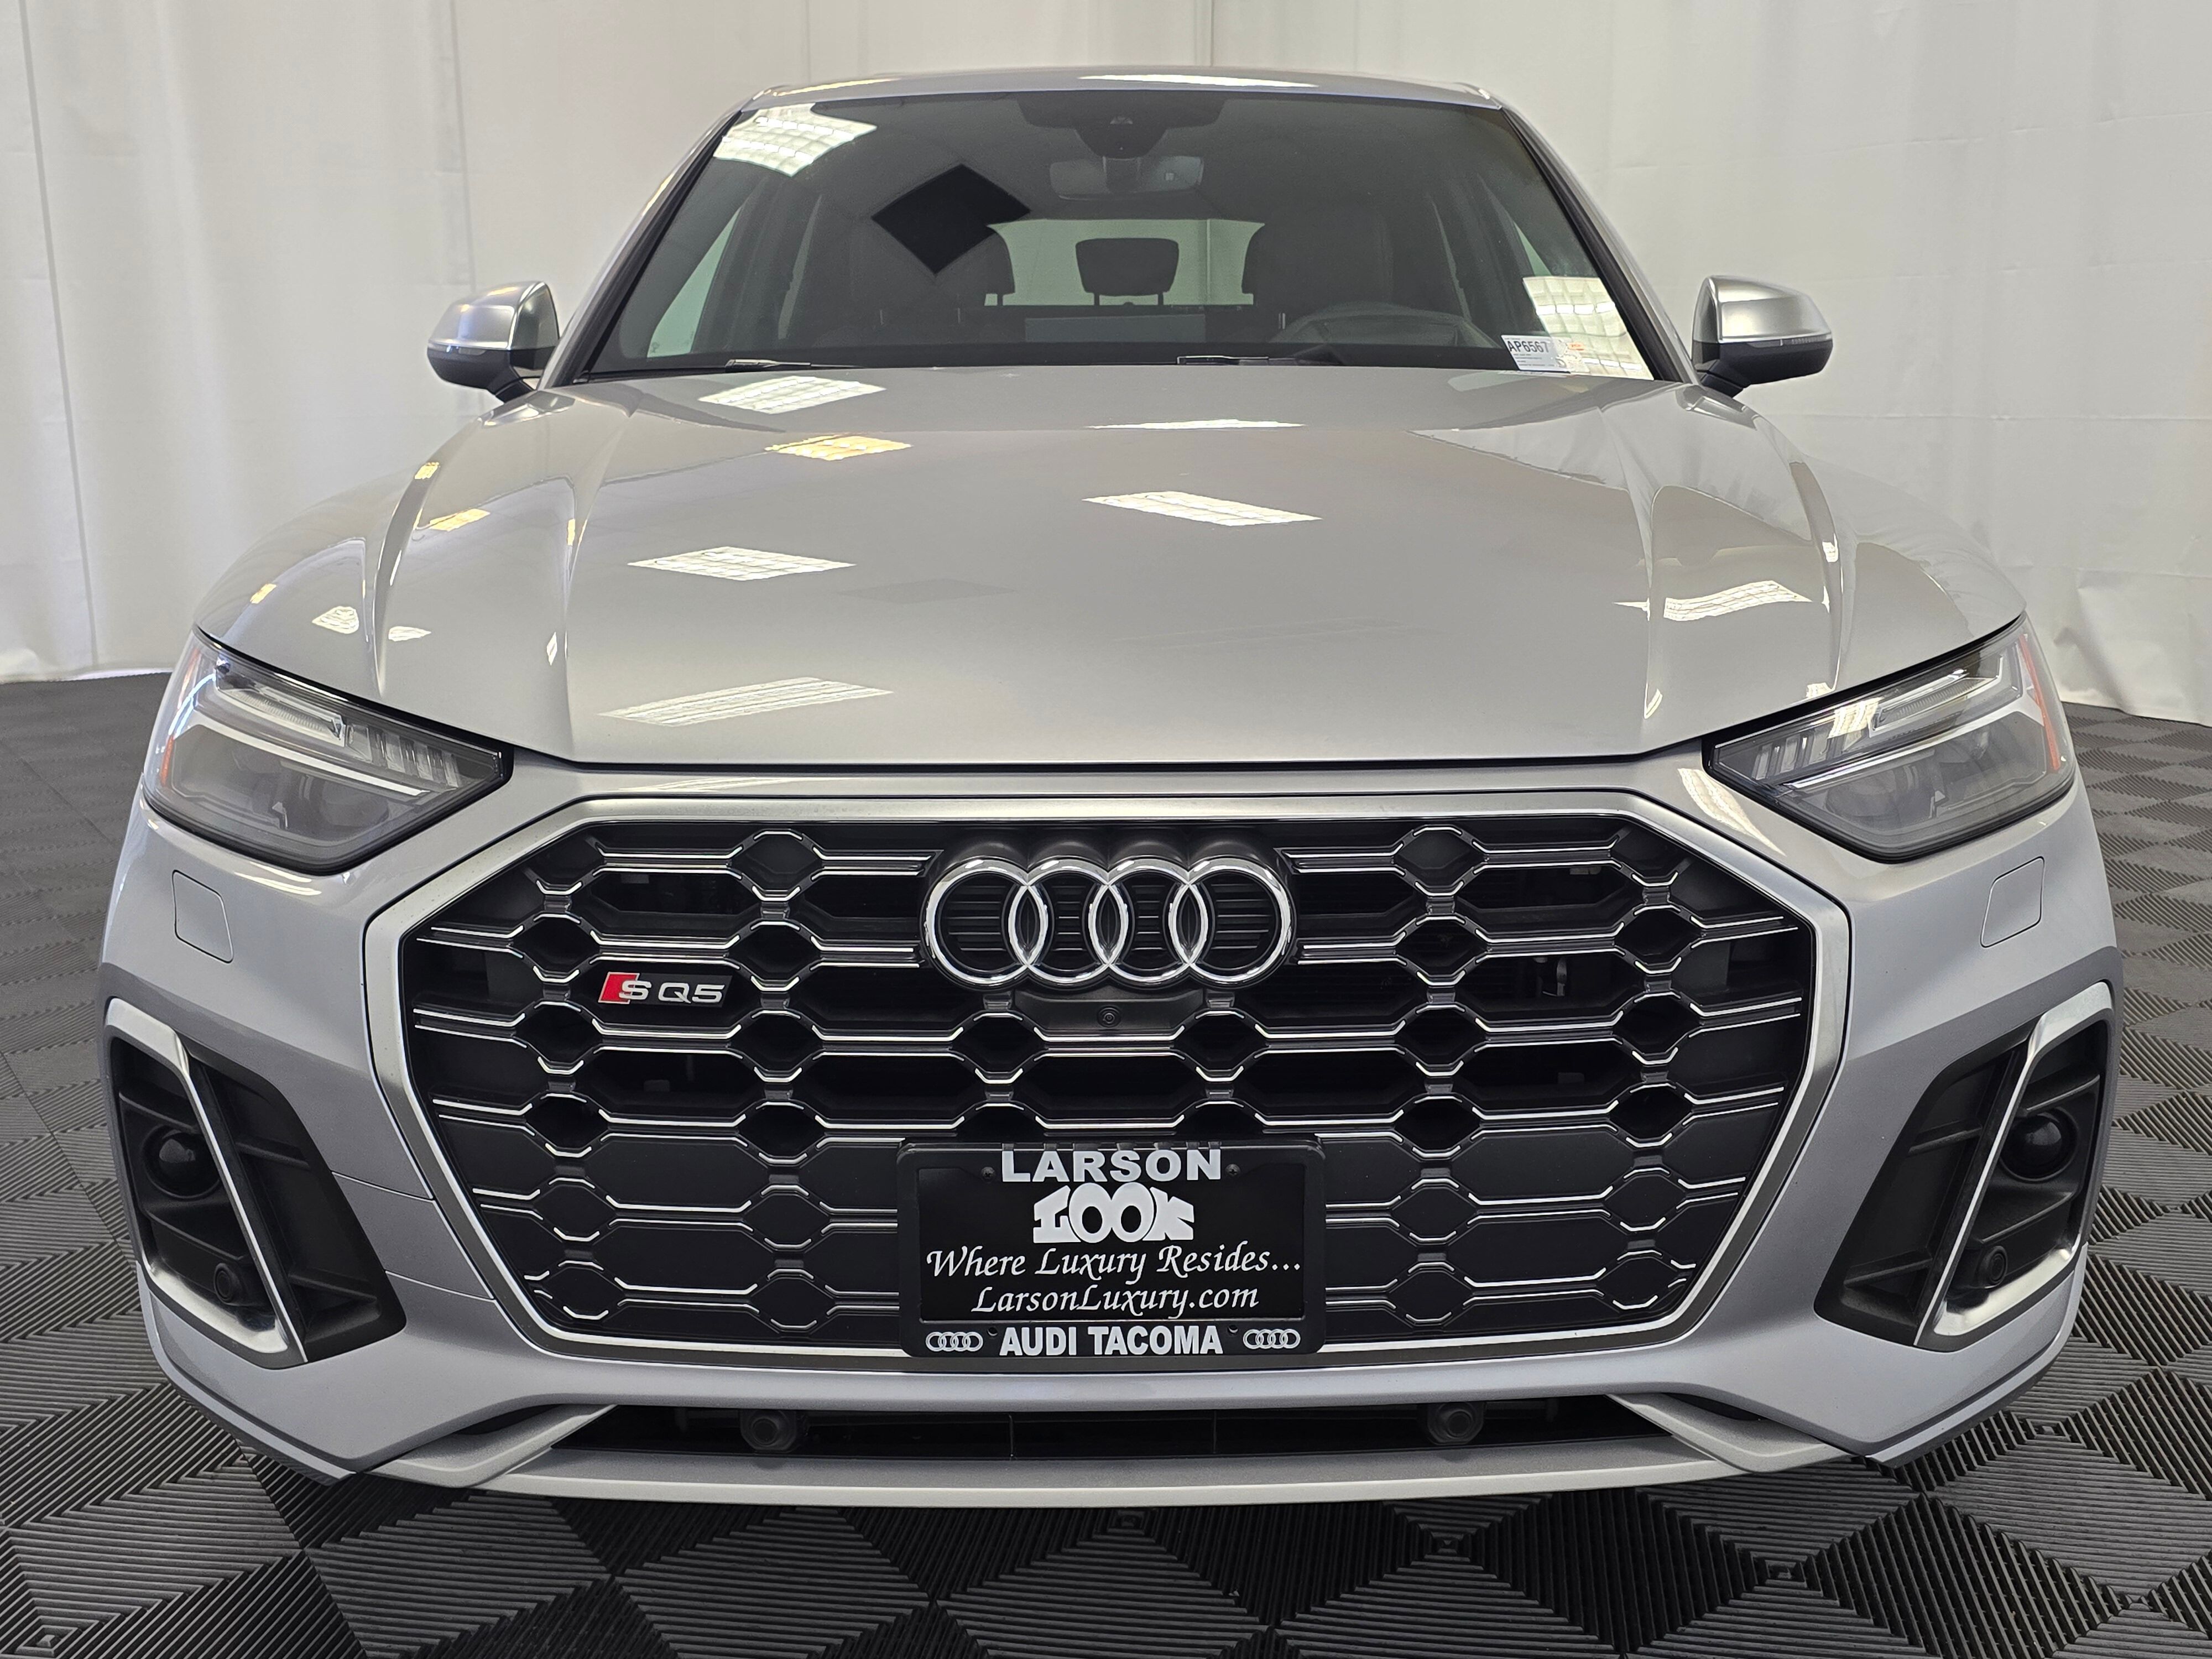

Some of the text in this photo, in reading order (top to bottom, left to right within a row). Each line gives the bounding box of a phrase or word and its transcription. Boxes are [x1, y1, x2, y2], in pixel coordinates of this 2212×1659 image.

[1506, 340, 1550, 352] AP6567
[1001, 1149, 1221, 1182] LARSON
[926, 1240, 1301, 1285] Where Luxury Resides...
[971, 1286, 1260, 1320] LarsonLuxury.com
[999, 1325, 1224, 1356] AUDI TACOMA
